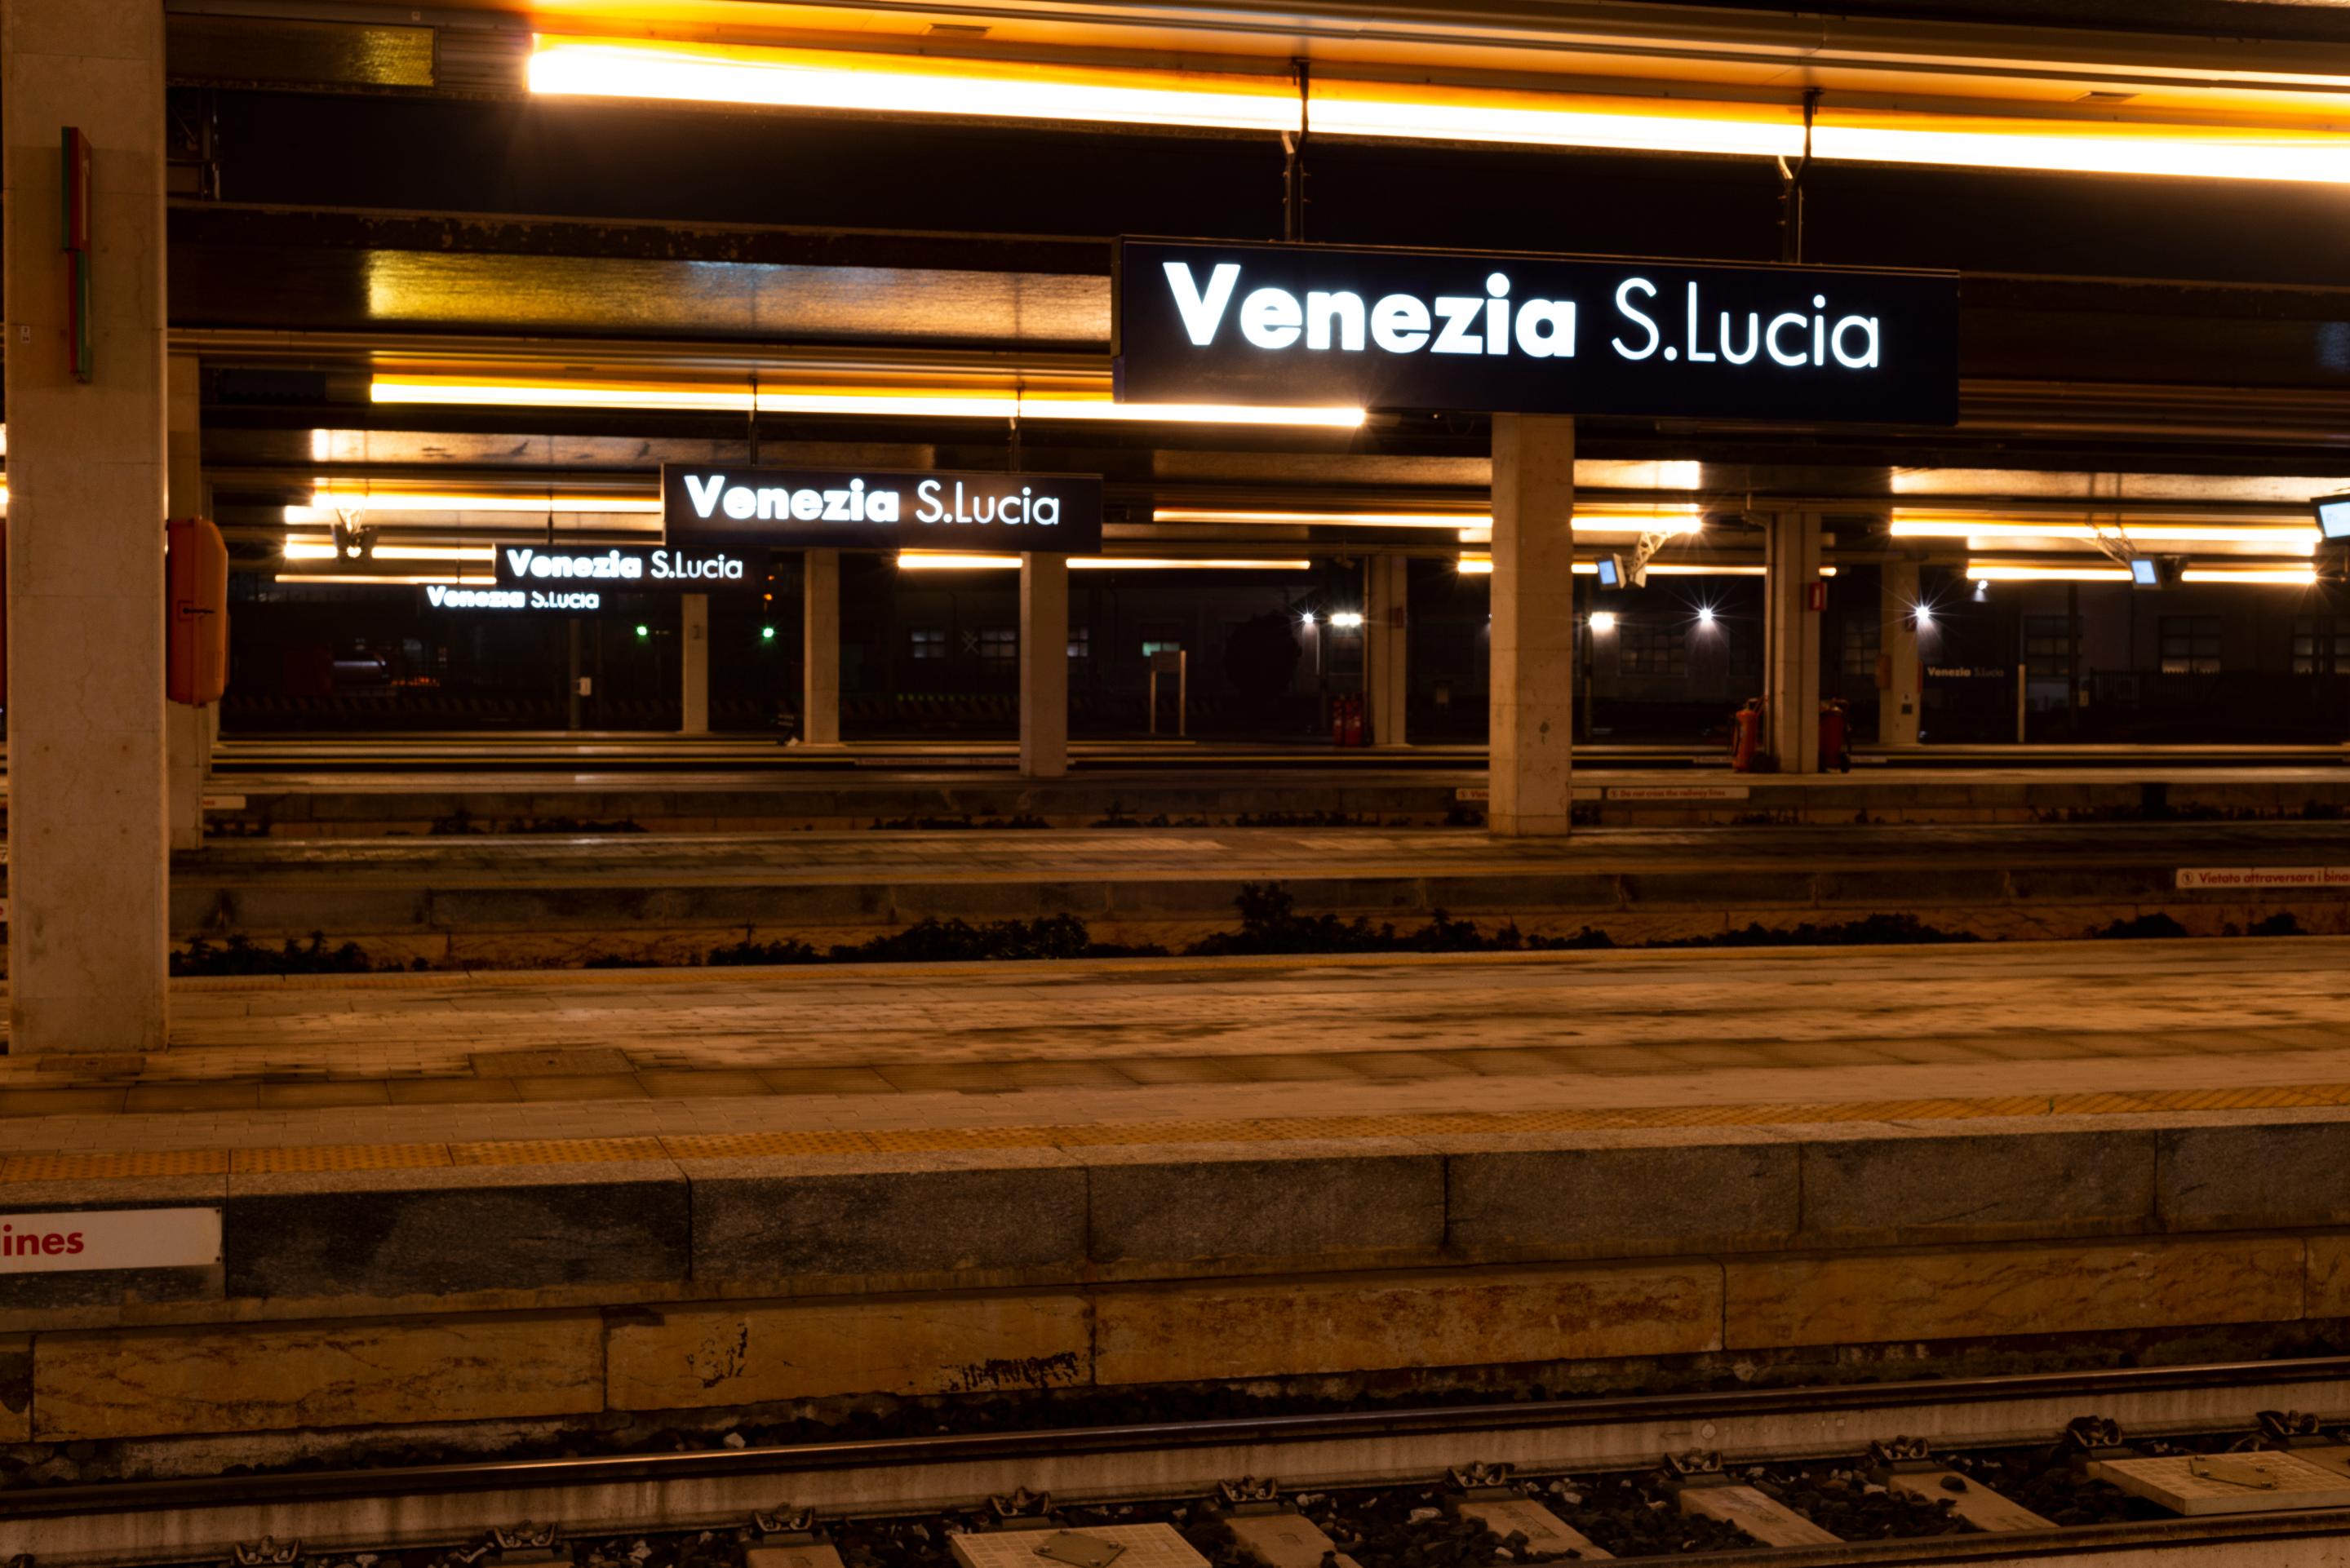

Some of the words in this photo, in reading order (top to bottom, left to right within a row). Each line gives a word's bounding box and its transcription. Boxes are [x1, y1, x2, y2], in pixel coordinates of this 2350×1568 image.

[1162, 261, 1576, 358] Venezia
[1612, 277, 1879, 369] S.Lucia
[683, 475, 900, 523] Venezia
[915, 479, 1060, 525] S.Lucia
[506, 548, 643, 579] Venezia
[650, 550, 743, 579] S.Lucia
[425, 585, 526, 609] Venezia
[530, 590, 600, 609] S.Lucia
[1926, 665, 1972, 678] Venezia
[2199, 872, 2241, 884] Vietato
[2244, 872, 2314, 884] attraversare
